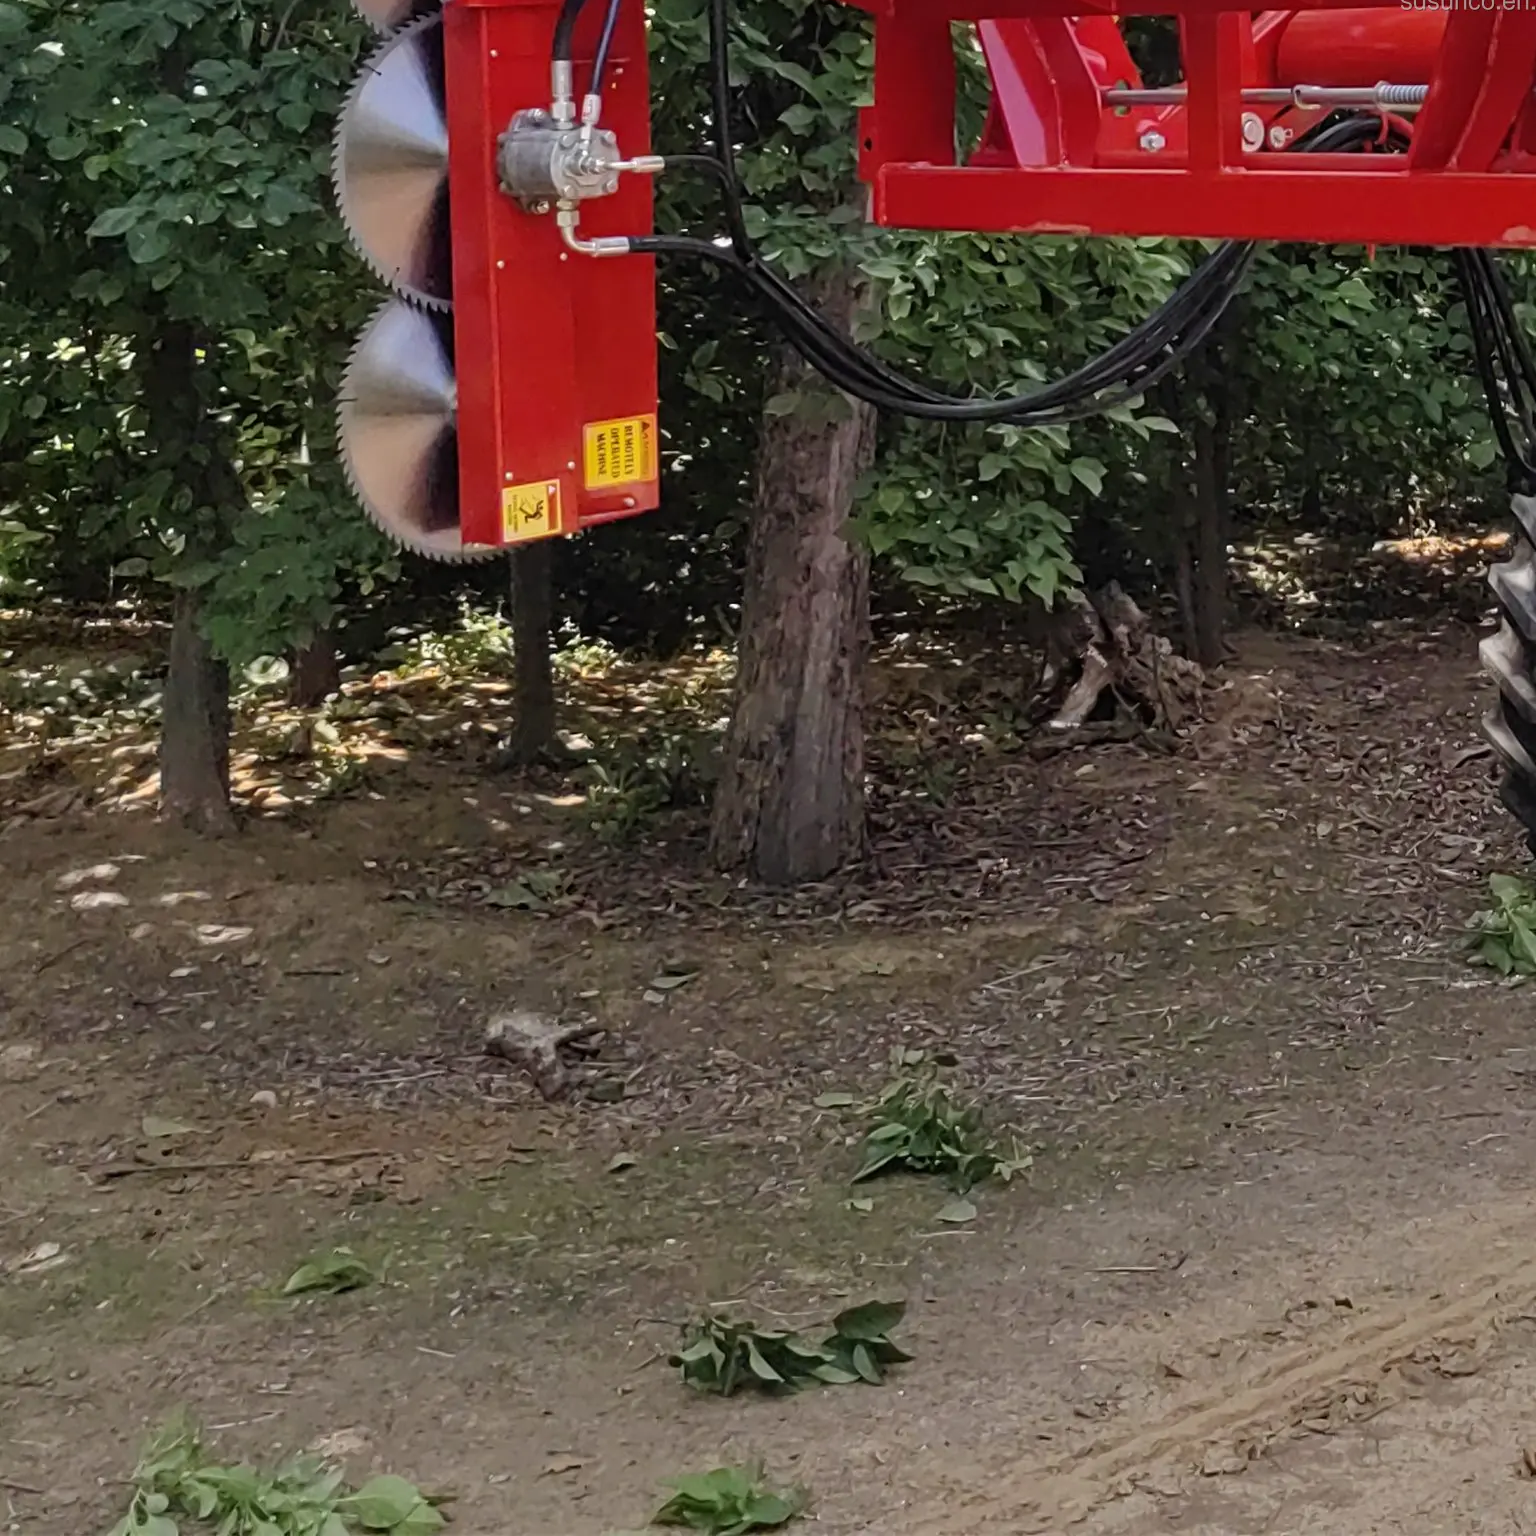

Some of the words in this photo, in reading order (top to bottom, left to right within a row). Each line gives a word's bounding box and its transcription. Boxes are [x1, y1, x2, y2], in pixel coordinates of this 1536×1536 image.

[596, 432, 607, 476] MACHINE
[610, 427, 621, 479] OPERATED
[624, 425, 635, 476] REMOTELY
